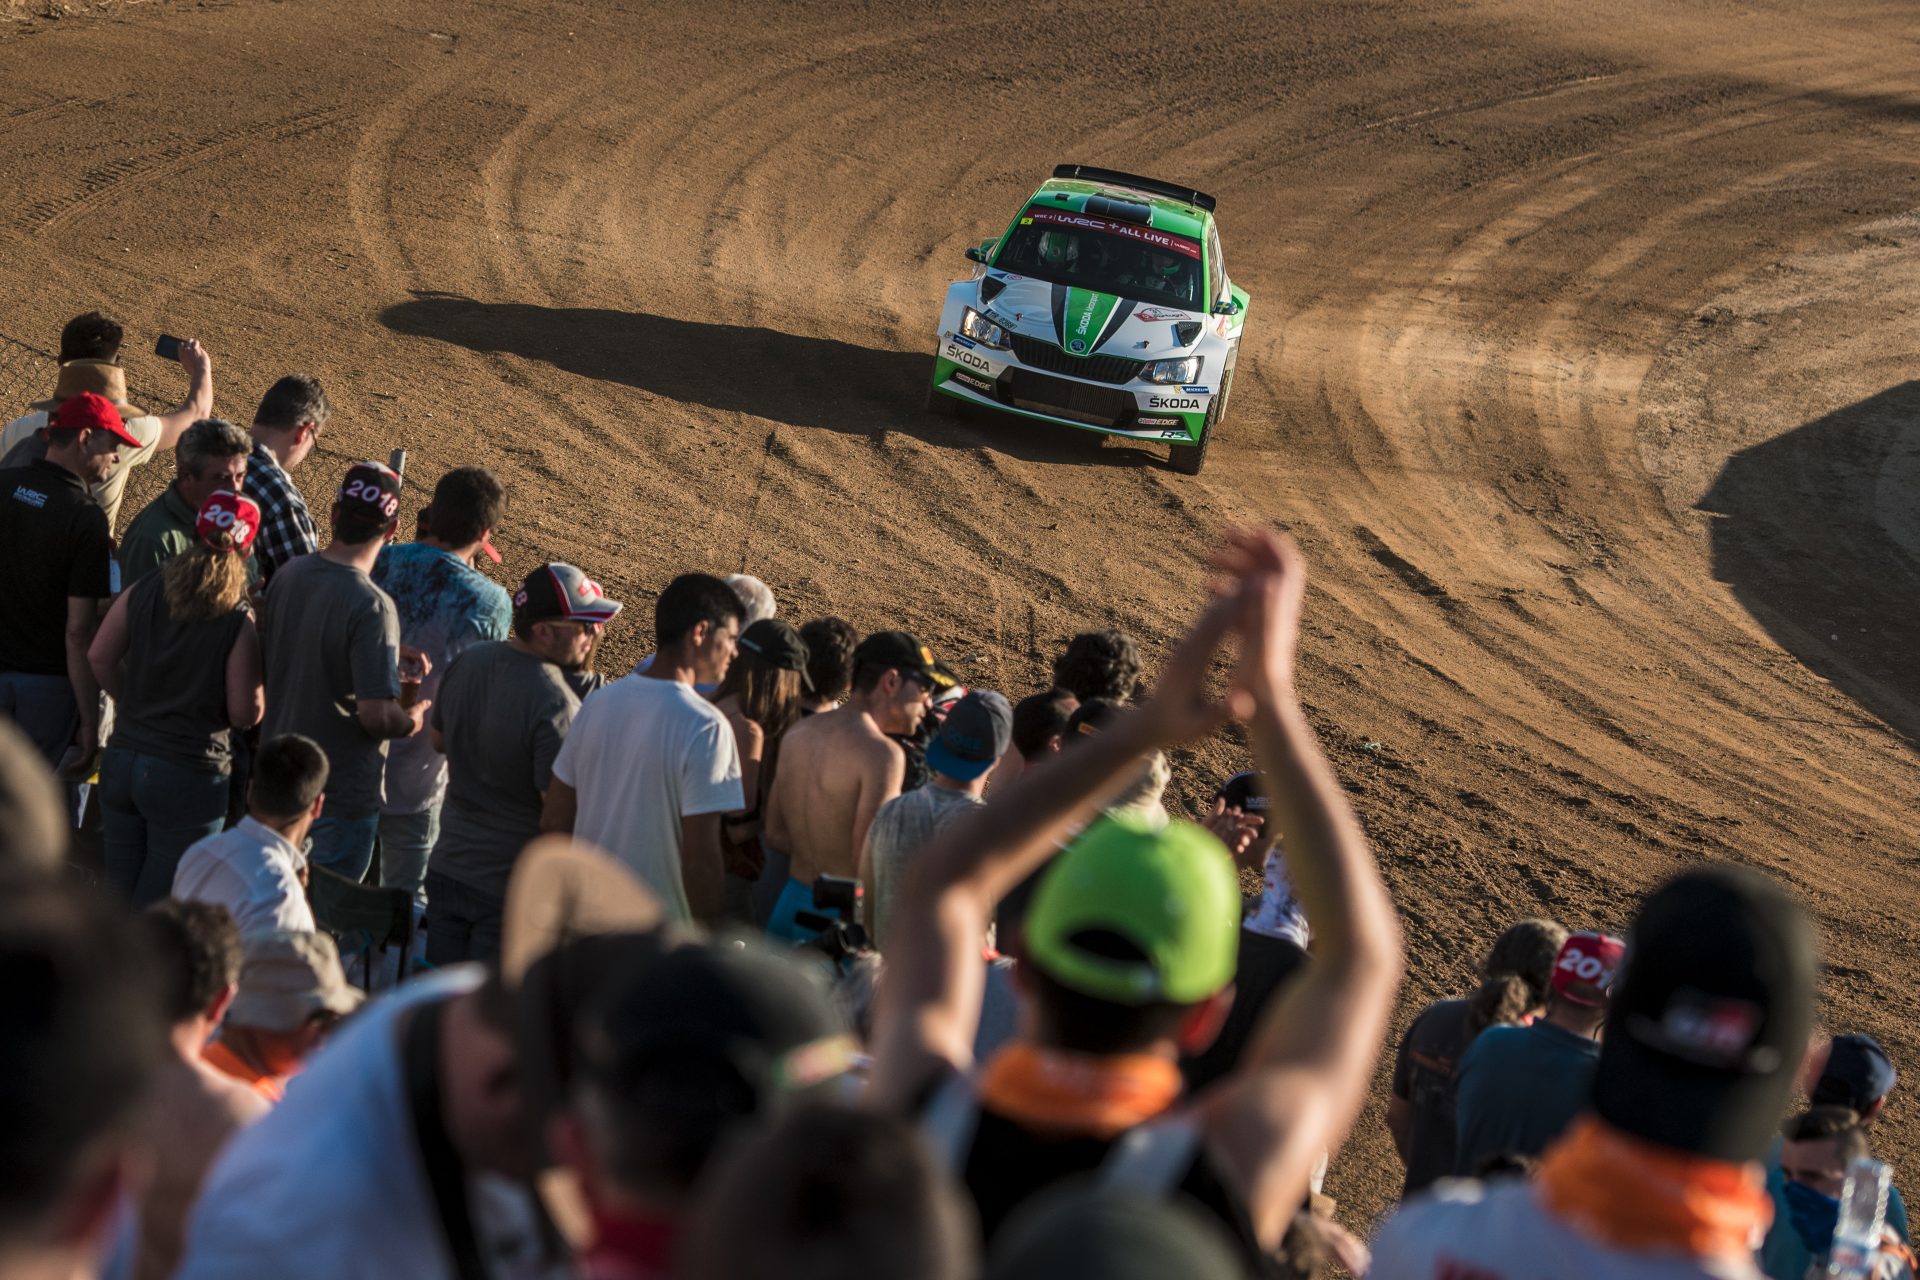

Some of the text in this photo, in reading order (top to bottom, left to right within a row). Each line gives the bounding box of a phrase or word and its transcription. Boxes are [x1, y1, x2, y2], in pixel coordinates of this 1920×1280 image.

[1058, 215, 1106, 229] WRC
[1119, 227, 1141, 238] ALL
[1143, 232, 1169, 246] LIVE
[1076, 311, 1092, 335] ŠKODA
[946, 344, 990, 372] ŠKODA
[970, 379, 992, 391] EDGE
[1149, 395, 1200, 409] ŠKODA
[16, 485, 48, 502] WRC
[345, 479, 399, 517] 2018
[203, 503, 251, 544] 2018
[1559, 947, 1614, 989] 201
